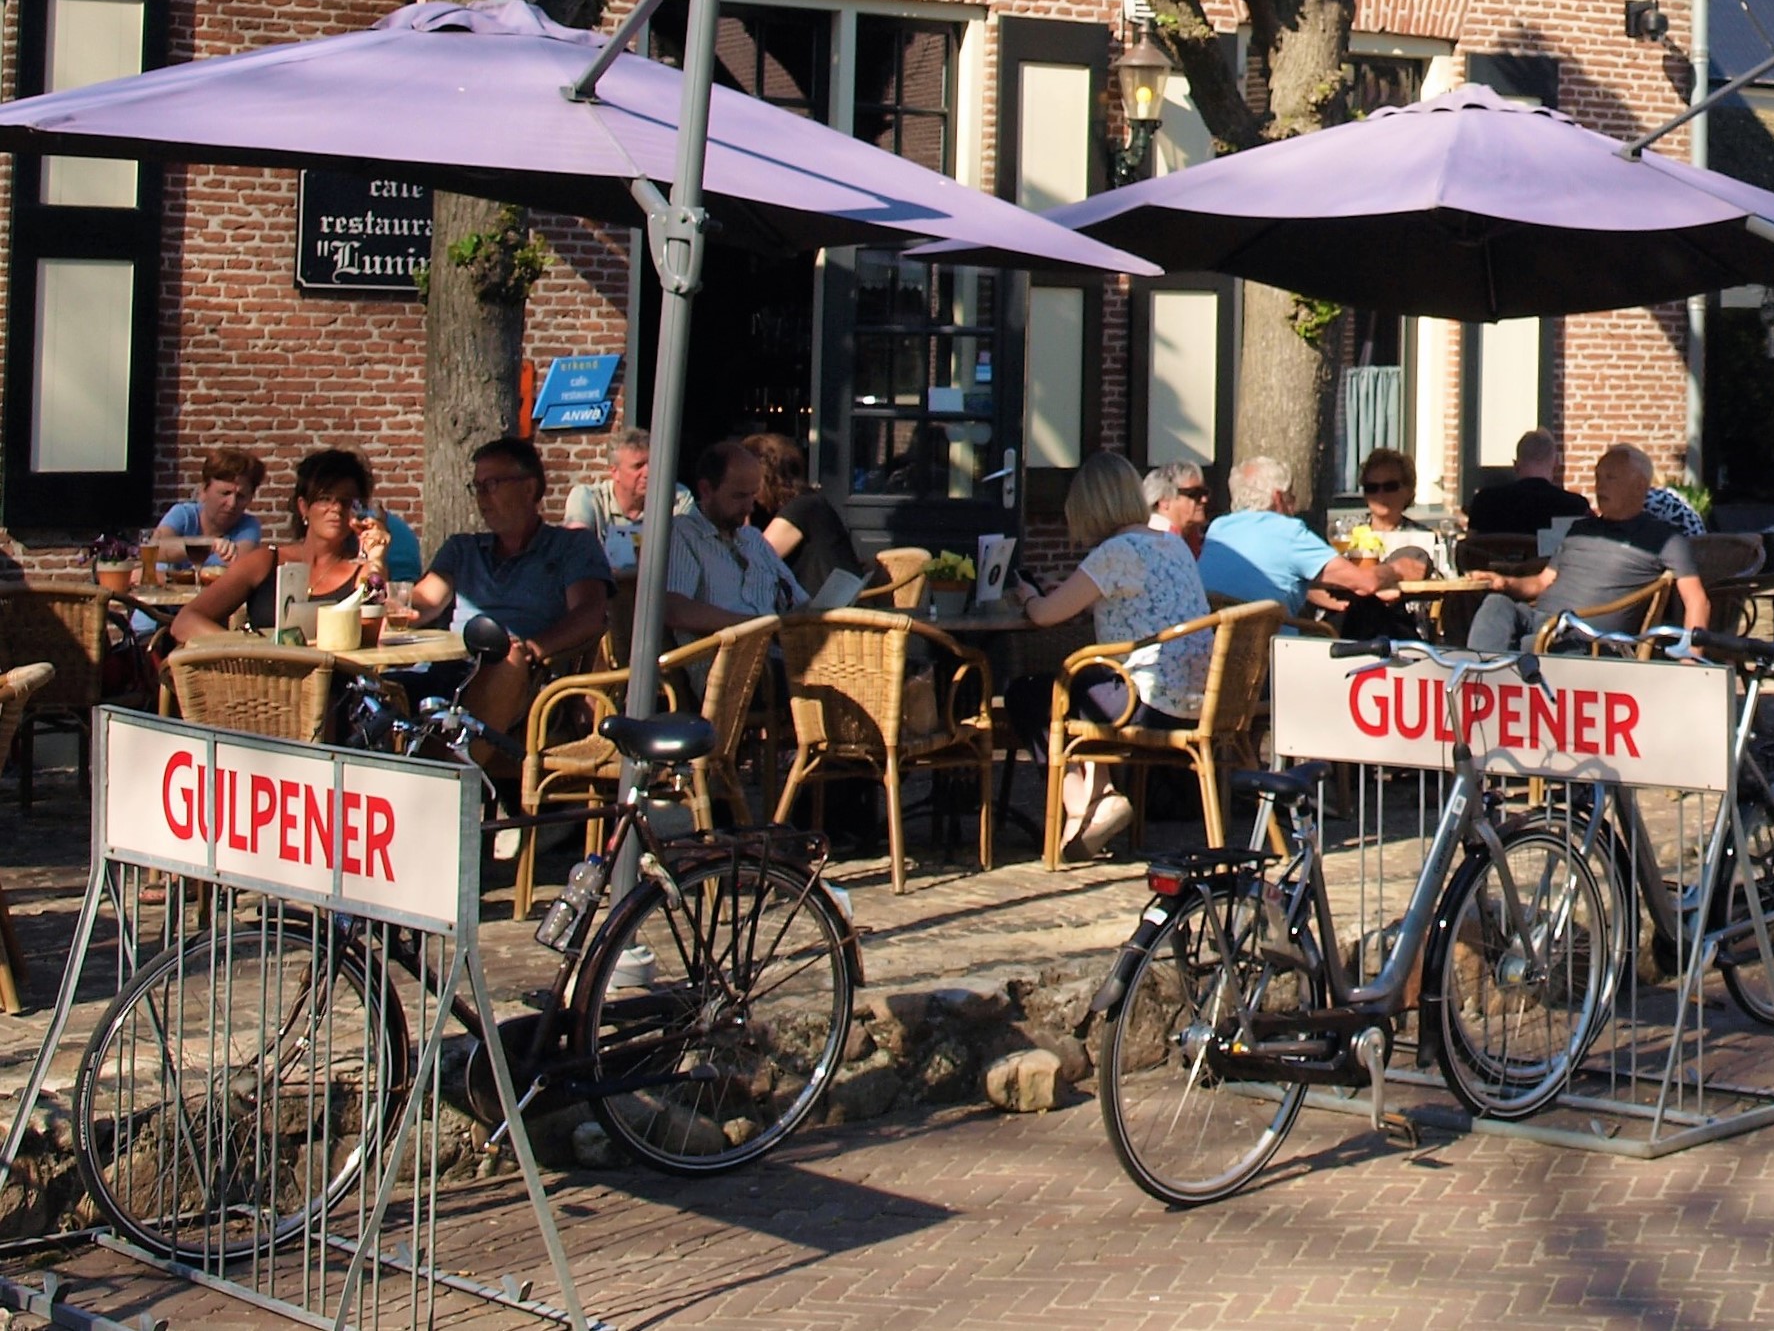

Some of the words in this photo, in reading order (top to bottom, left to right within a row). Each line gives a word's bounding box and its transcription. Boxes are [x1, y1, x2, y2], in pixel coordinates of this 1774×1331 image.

[561, 407, 601, 422] ANWB
[1348, 666, 1642, 759] GULPENER
[162, 750, 396, 883] GULPENER
